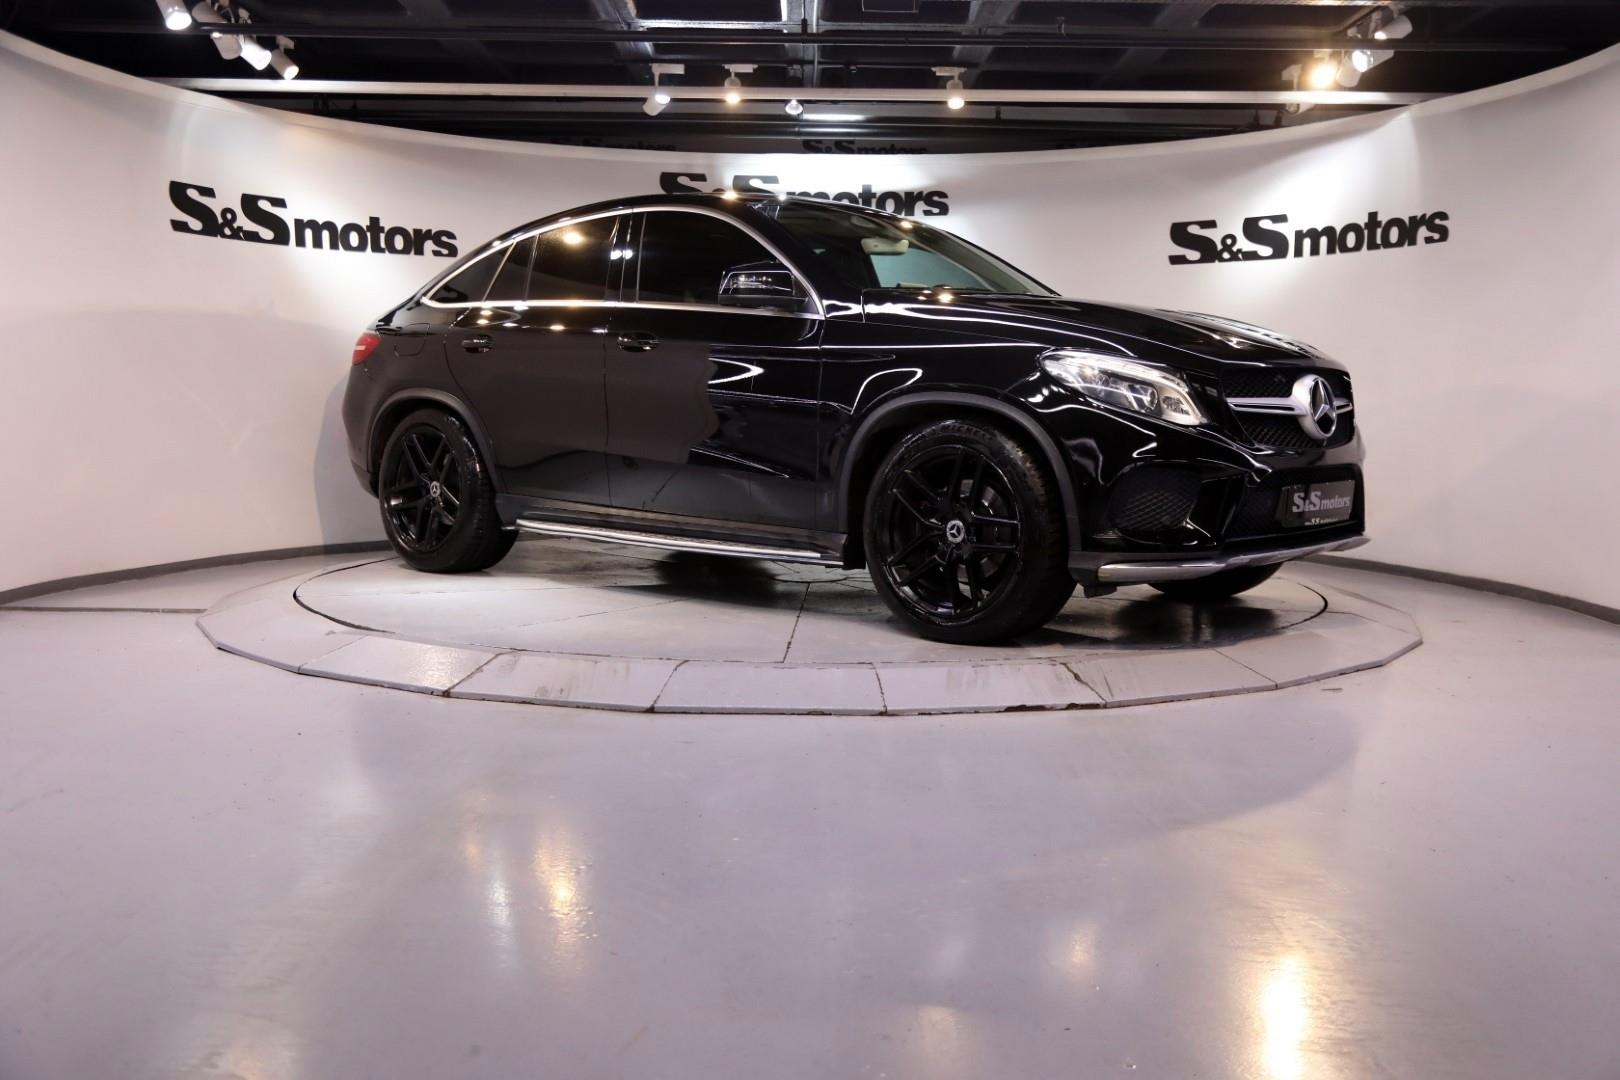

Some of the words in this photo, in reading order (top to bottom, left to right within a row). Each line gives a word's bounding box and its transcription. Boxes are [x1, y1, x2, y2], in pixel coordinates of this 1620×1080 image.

[169, 180, 290, 246] S&S
[294, 216, 458, 258] motors
[659, 171, 780, 195] SS
[786, 184, 949, 217] otors
[1168, 214, 1289, 265] S&S
[1294, 211, 1449, 258] motors
[1321, 496, 1351, 510] motors
